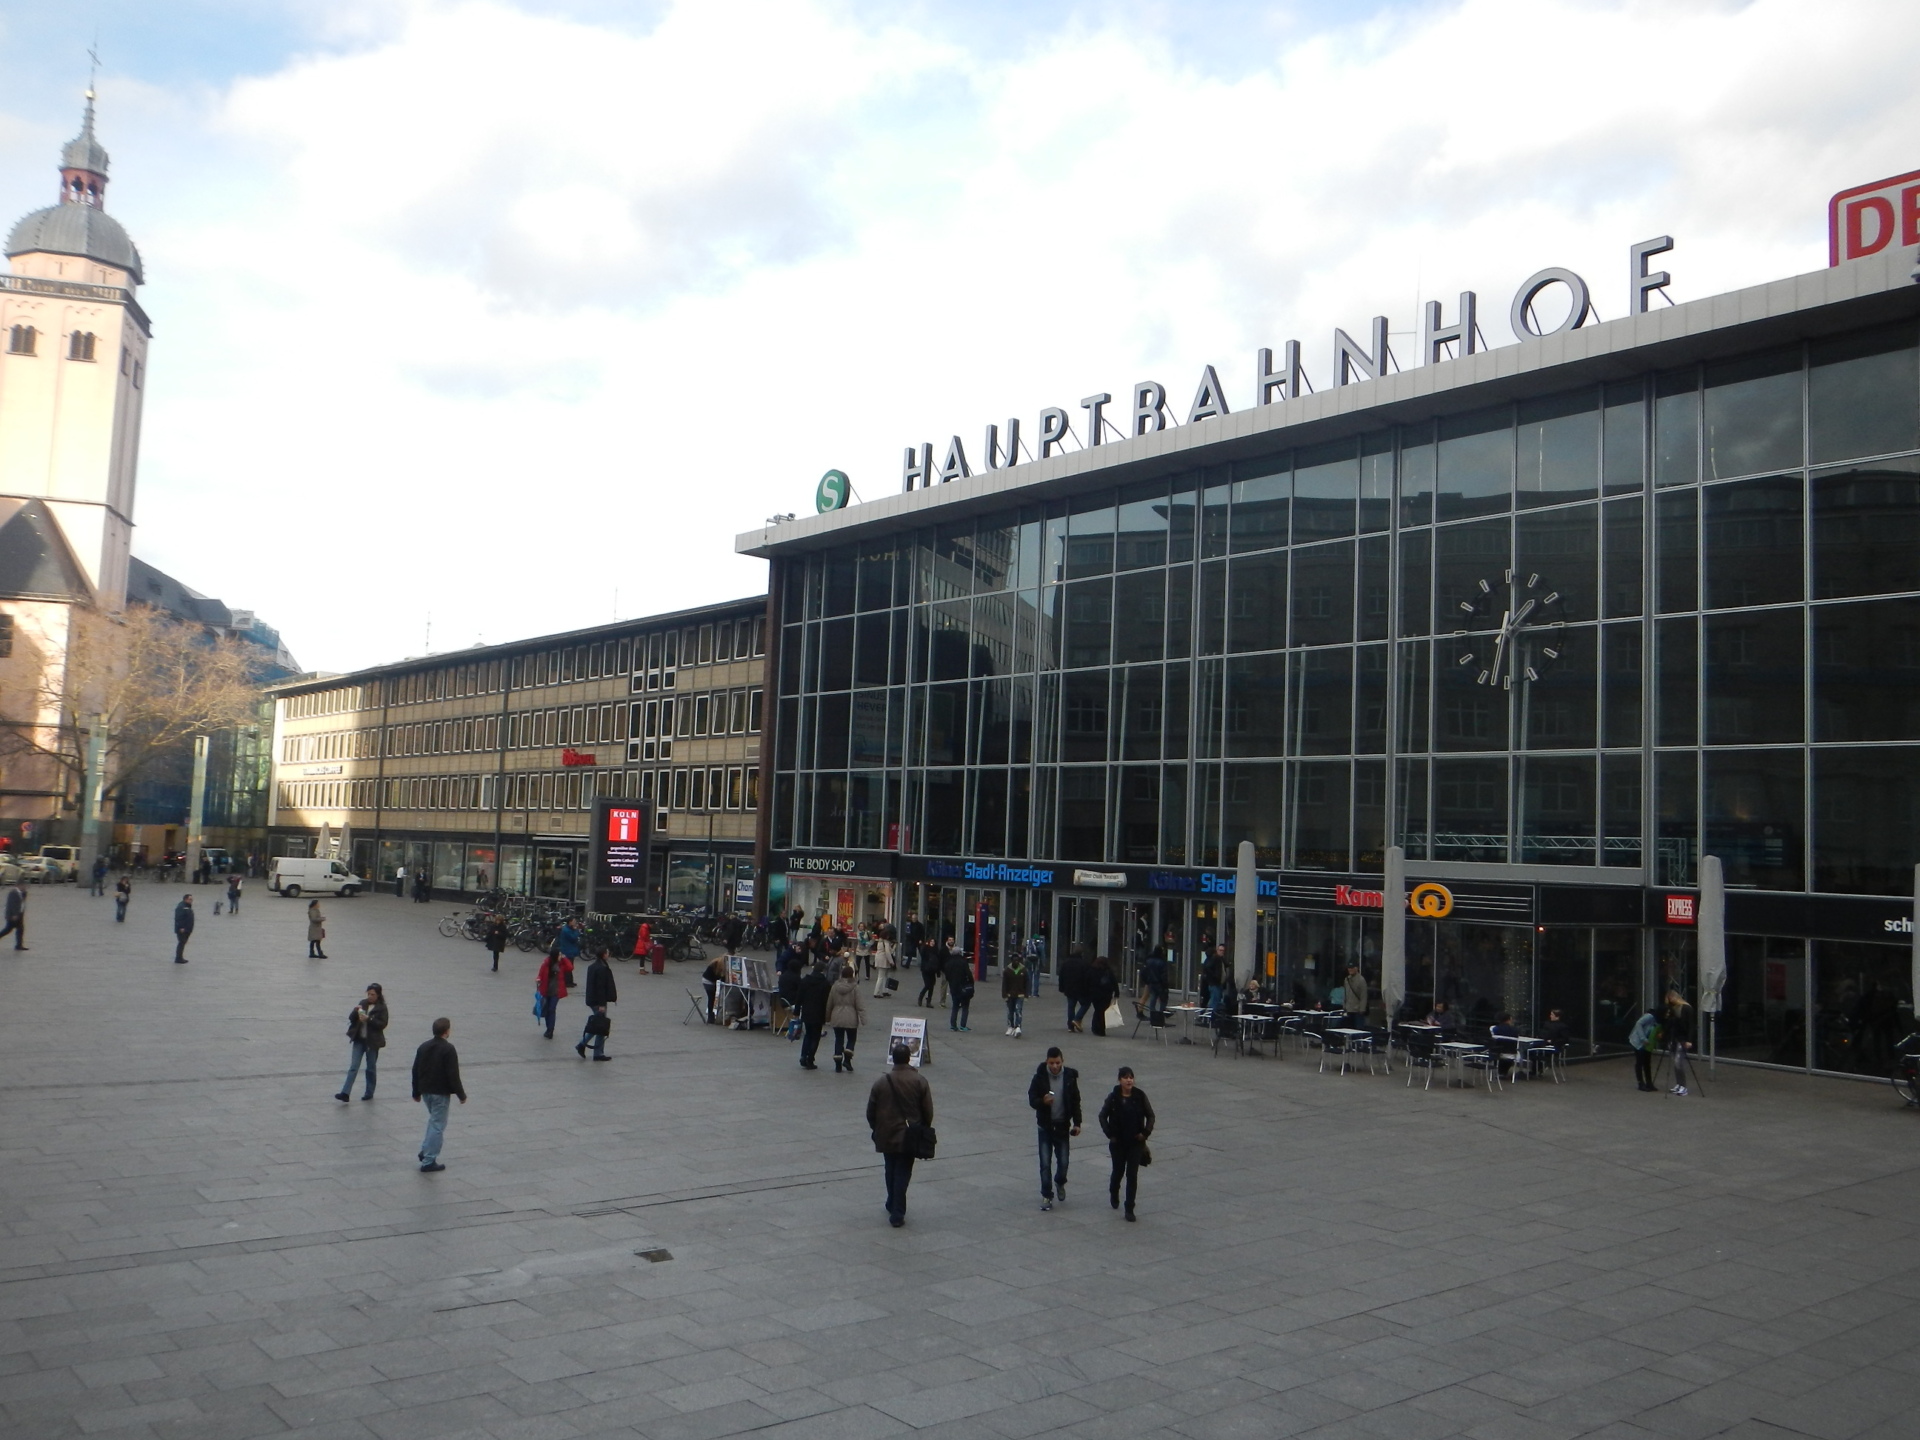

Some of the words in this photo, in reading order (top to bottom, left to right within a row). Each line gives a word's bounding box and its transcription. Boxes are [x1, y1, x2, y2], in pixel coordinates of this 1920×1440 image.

[902, 235, 1674, 494] HAUPTBAHNHOF
[821, 475, 839, 511] S
[789, 857, 804, 870] THE
[806, 857, 831, 871] BODY
[831, 859, 856, 872] SHOP
[611, 875, 623, 884] 150
[927, 861, 962, 878] Kölner
[965, 861, 1054, 887] Stadt-Anzeiger
[1147, 870, 1198, 891] Kölner
[838, 902, 853, 916] SALE
[1667, 899, 1693, 916] EXPRESS
[1884, 916, 1914, 933] sch
